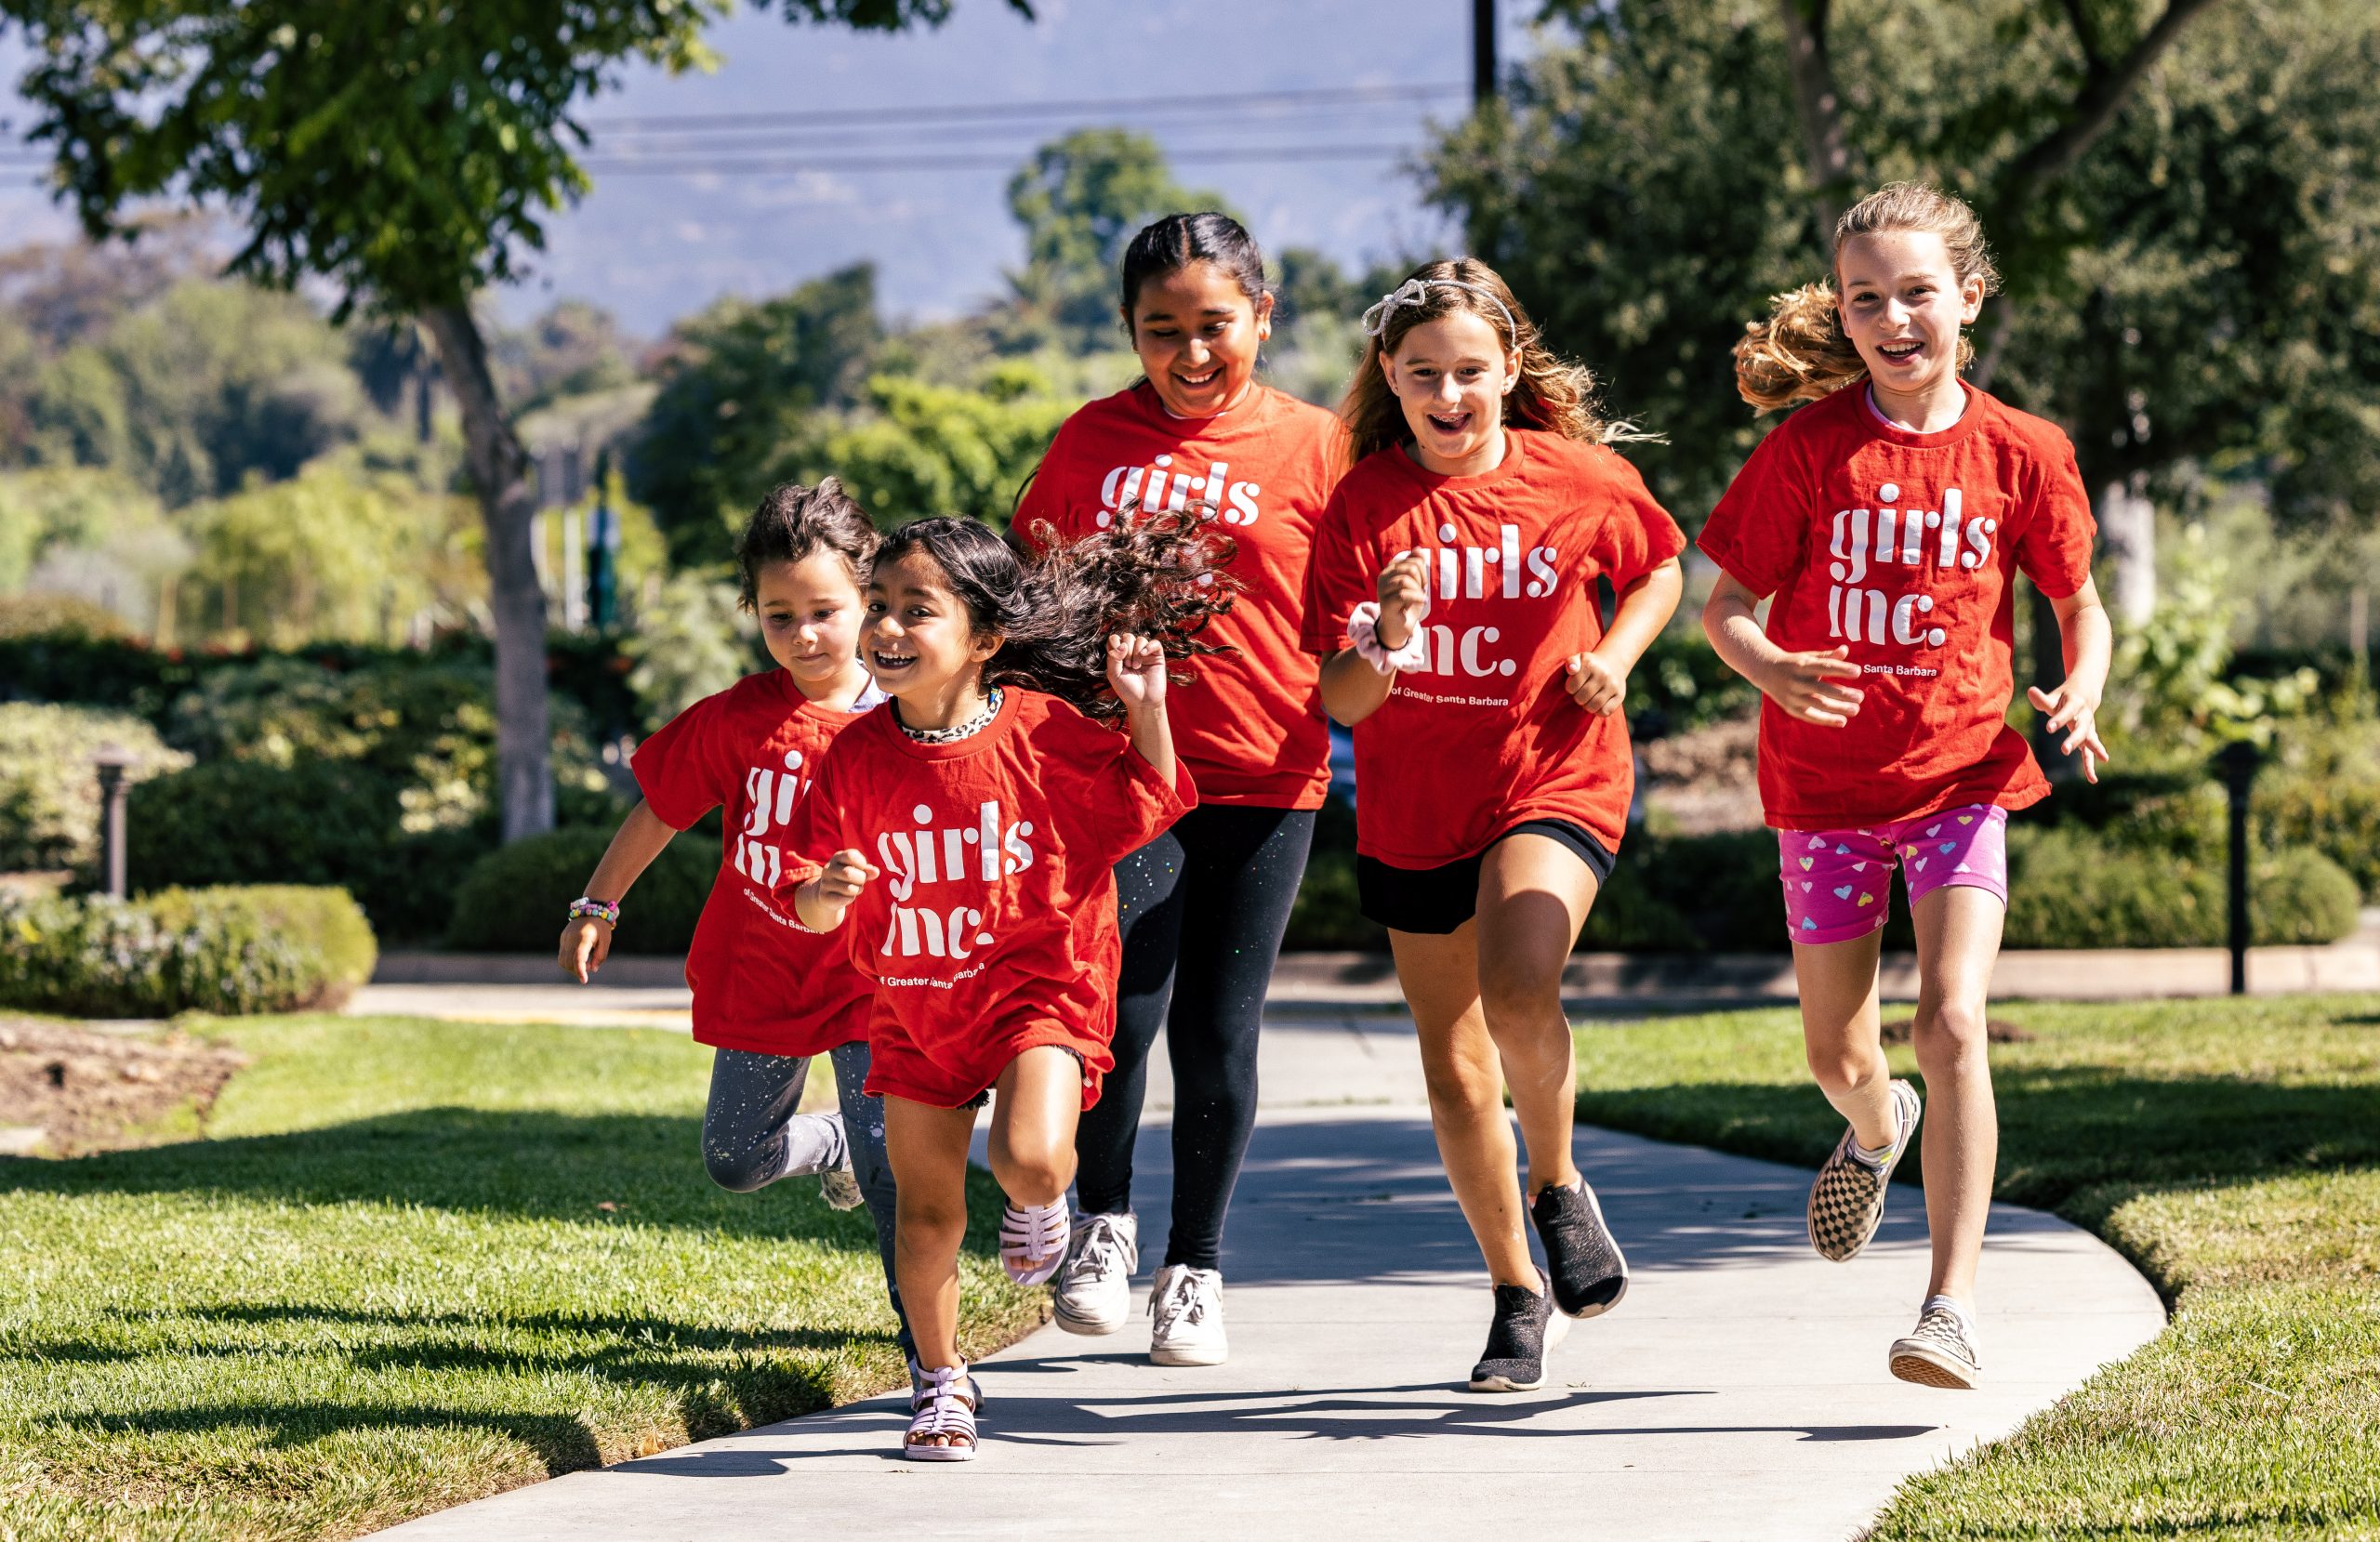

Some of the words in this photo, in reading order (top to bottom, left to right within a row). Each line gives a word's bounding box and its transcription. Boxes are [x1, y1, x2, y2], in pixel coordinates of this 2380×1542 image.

[1096, 454, 1262, 528] girls
[1829, 482, 1997, 584] girls
[1828, 585, 1946, 647] inc.
[1419, 625, 1517, 678] nc.
[1863, 664, 1894, 675] Santa
[1896, 665, 1937, 678] Barbara
[1391, 687, 1402, 696] of
[1403, 687, 1435, 704] Greater
[1435, 694, 1466, 705] Santa
[1468, 695, 1509, 706] Barbara
[877, 800, 1035, 903] girls
[887, 976, 929, 987] Greater
[930, 976, 954, 990] anta
